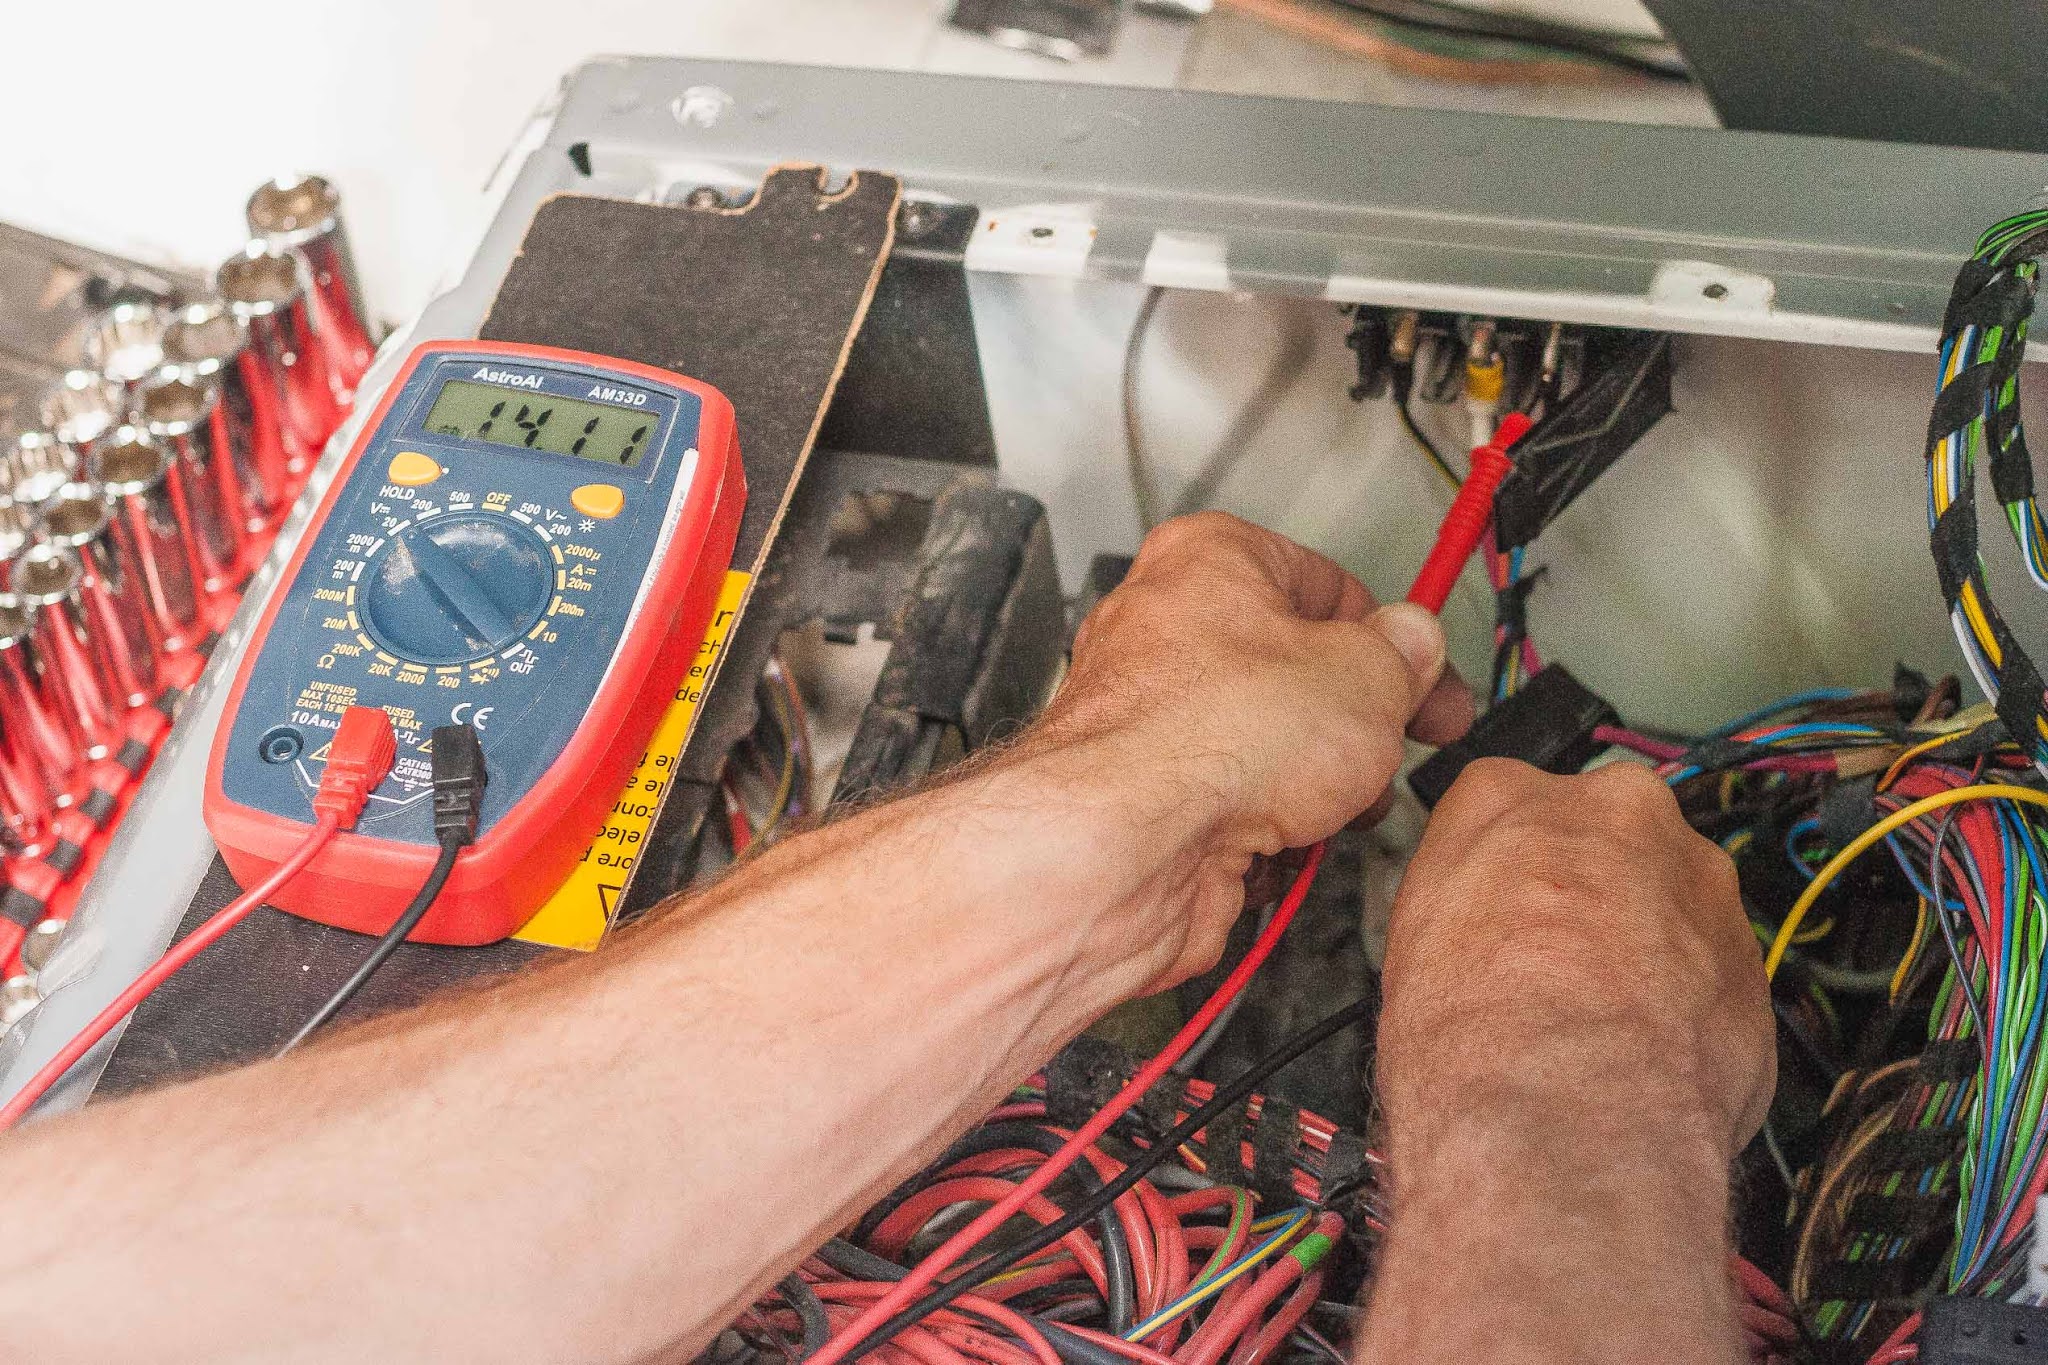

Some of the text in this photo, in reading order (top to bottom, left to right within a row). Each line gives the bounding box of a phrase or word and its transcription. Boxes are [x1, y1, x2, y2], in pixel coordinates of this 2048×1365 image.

[473, 367, 544, 389] AstroAI
[587, 385, 647, 406] AM33D
[379, 485, 415, 500] HOLD
[449, 491, 470, 502] 500
[486, 492, 512, 505] OFF
[411, 499, 433, 511] 200
[519, 502, 541, 515] 500
[381, 516, 398, 528] 20
[549, 523, 571, 536] 200
[346, 533, 375, 547] 2000
[349, 544, 361, 553] m
[332, 559, 356, 572] 200
[331, 570, 344, 579] m
[566, 577, 592, 591] 20m
[313, 588, 346, 602] 200M
[558, 602, 585, 617] 200m
[322, 617, 348, 631] 20M
[542, 631, 557, 643] 10
[331, 643, 363, 657] 200K
[367, 662, 393, 677] 20K
[510, 661, 534, 675] OUT
[395, 671, 426, 685] 2000
[437, 675, 461, 689] 200
[310, 681, 357, 696] UNFUSED
[301, 689, 357, 706] MAX 10SEC
[296, 697, 323, 710] EACH
[334, 704, 348, 714] MI
[451, 702, 494, 731] CE
[399, 719, 423, 730] MAX
